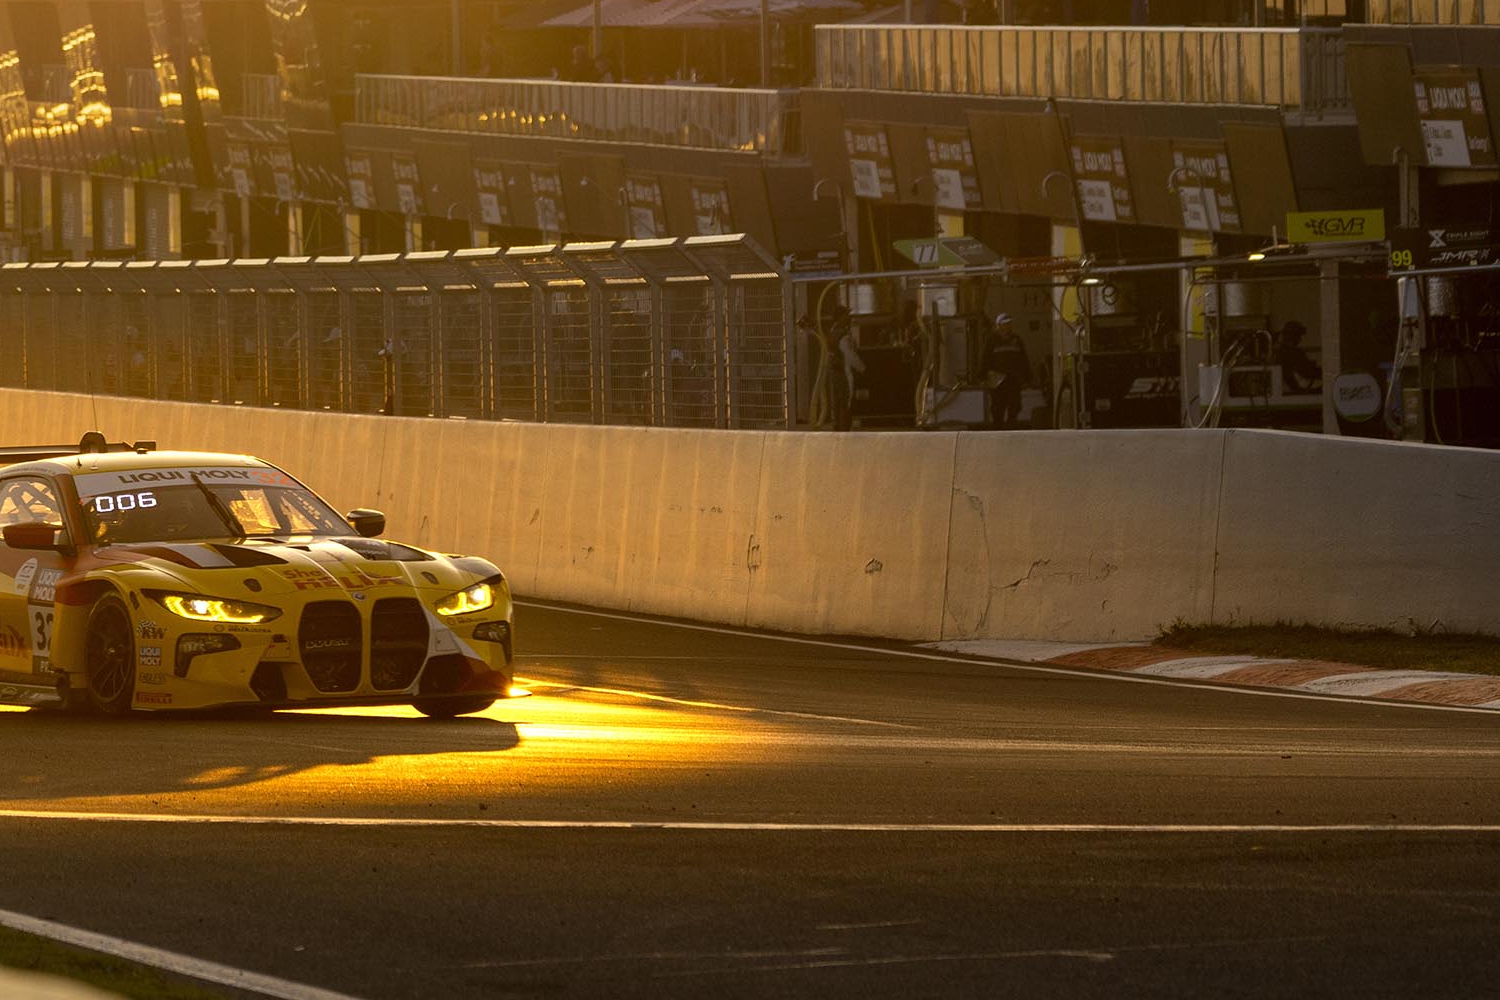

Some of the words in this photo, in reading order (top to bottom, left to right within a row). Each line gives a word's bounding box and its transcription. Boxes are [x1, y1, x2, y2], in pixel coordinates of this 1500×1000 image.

[915, 244, 936, 262] 77
[1392, 250, 1412, 267] 99
[118, 471, 185, 484] LIQUI
[189, 470, 251, 479] MOLY
[95, 491, 158, 513] 006
[140, 647, 161, 656] LIQUI
[140, 657, 161, 666] MOLY
